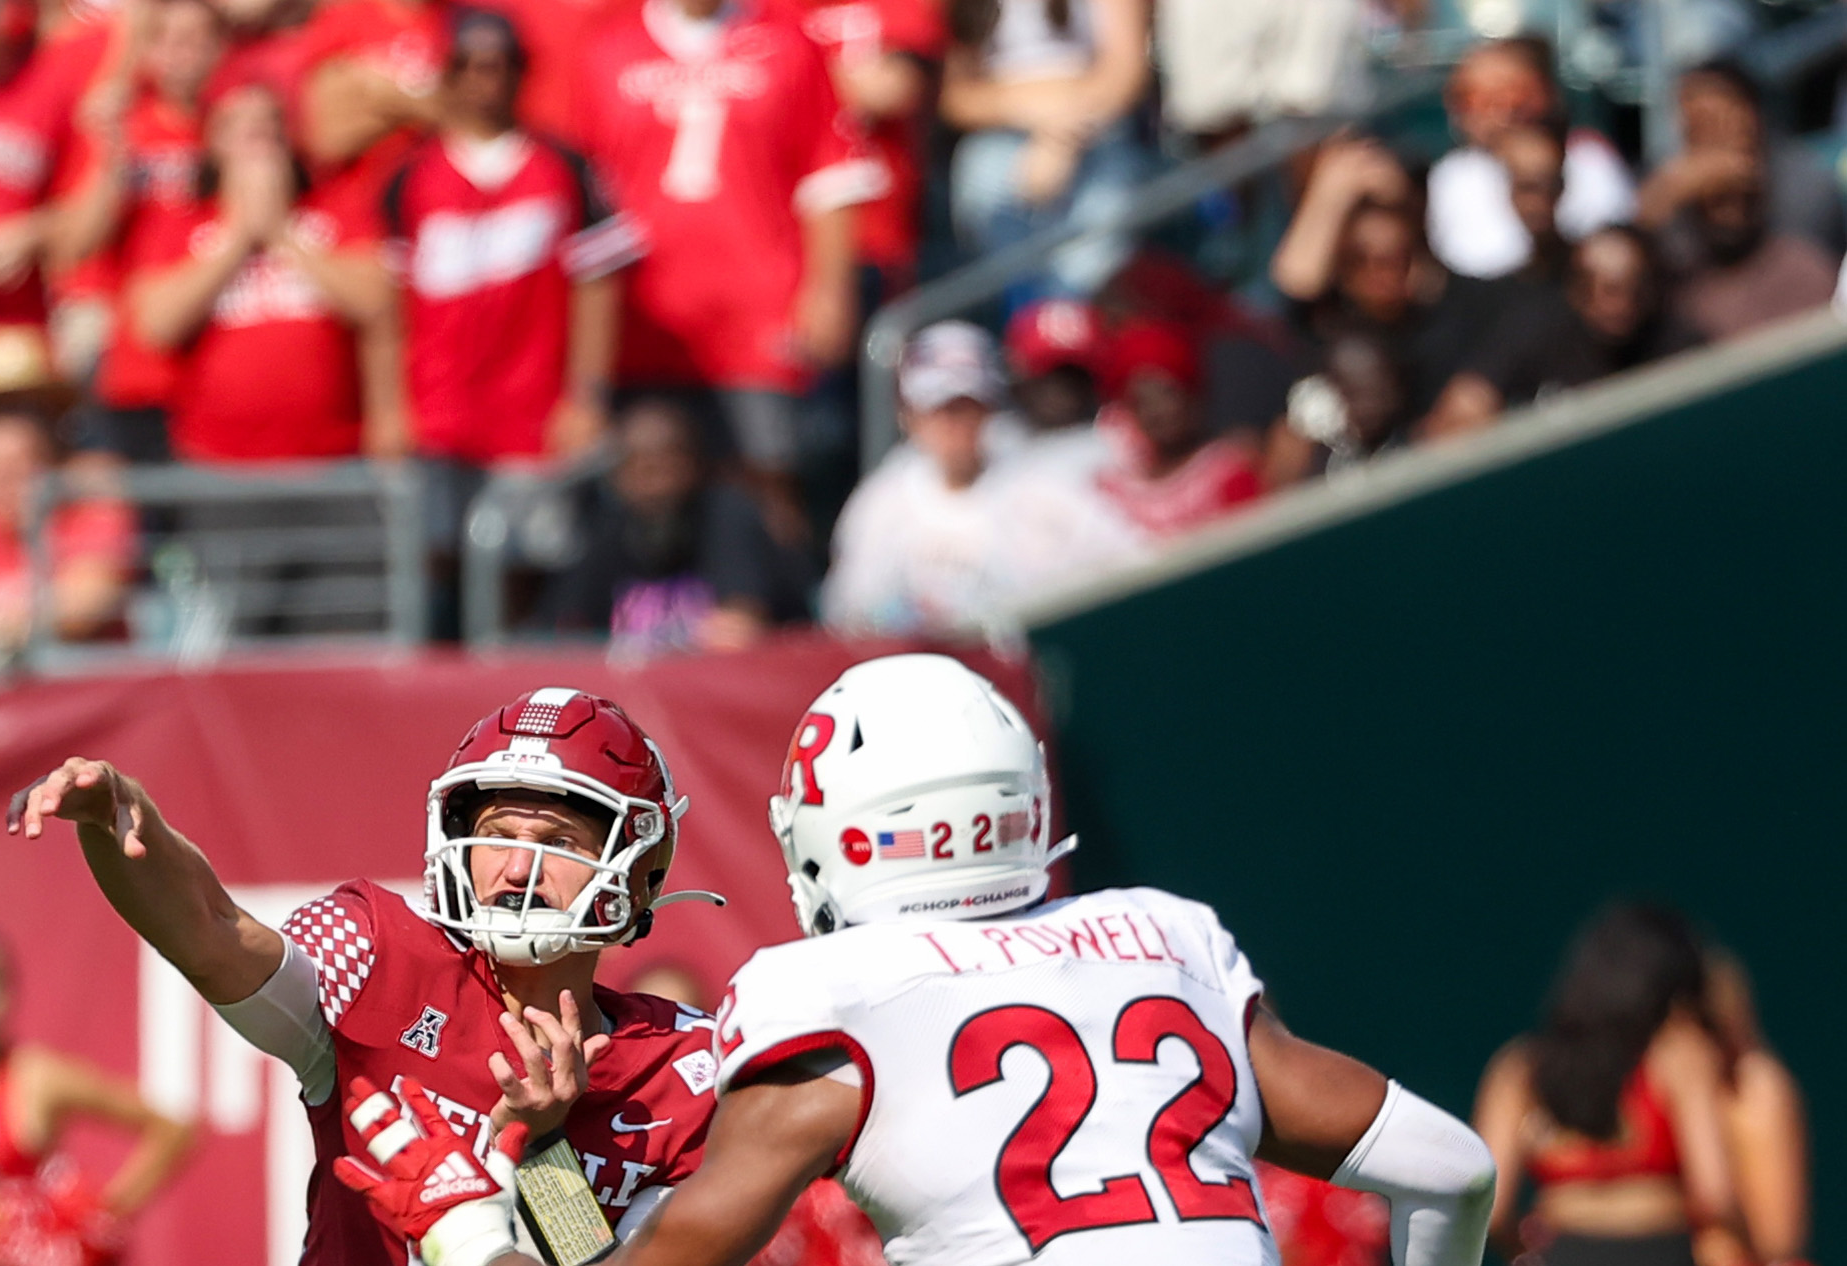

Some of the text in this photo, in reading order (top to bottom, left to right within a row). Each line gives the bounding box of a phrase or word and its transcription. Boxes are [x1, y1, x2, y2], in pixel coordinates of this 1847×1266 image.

[782, 711, 836, 806] R
[930, 813, 994, 860] 22
[899, 885, 1031, 915] #CHOP4CHANGE
[980, 912, 1186, 967] POWELL
[400, 1005, 448, 1058] A
[946, 995, 1269, 1257] 22
[418, 1175, 491, 1205] adidas
